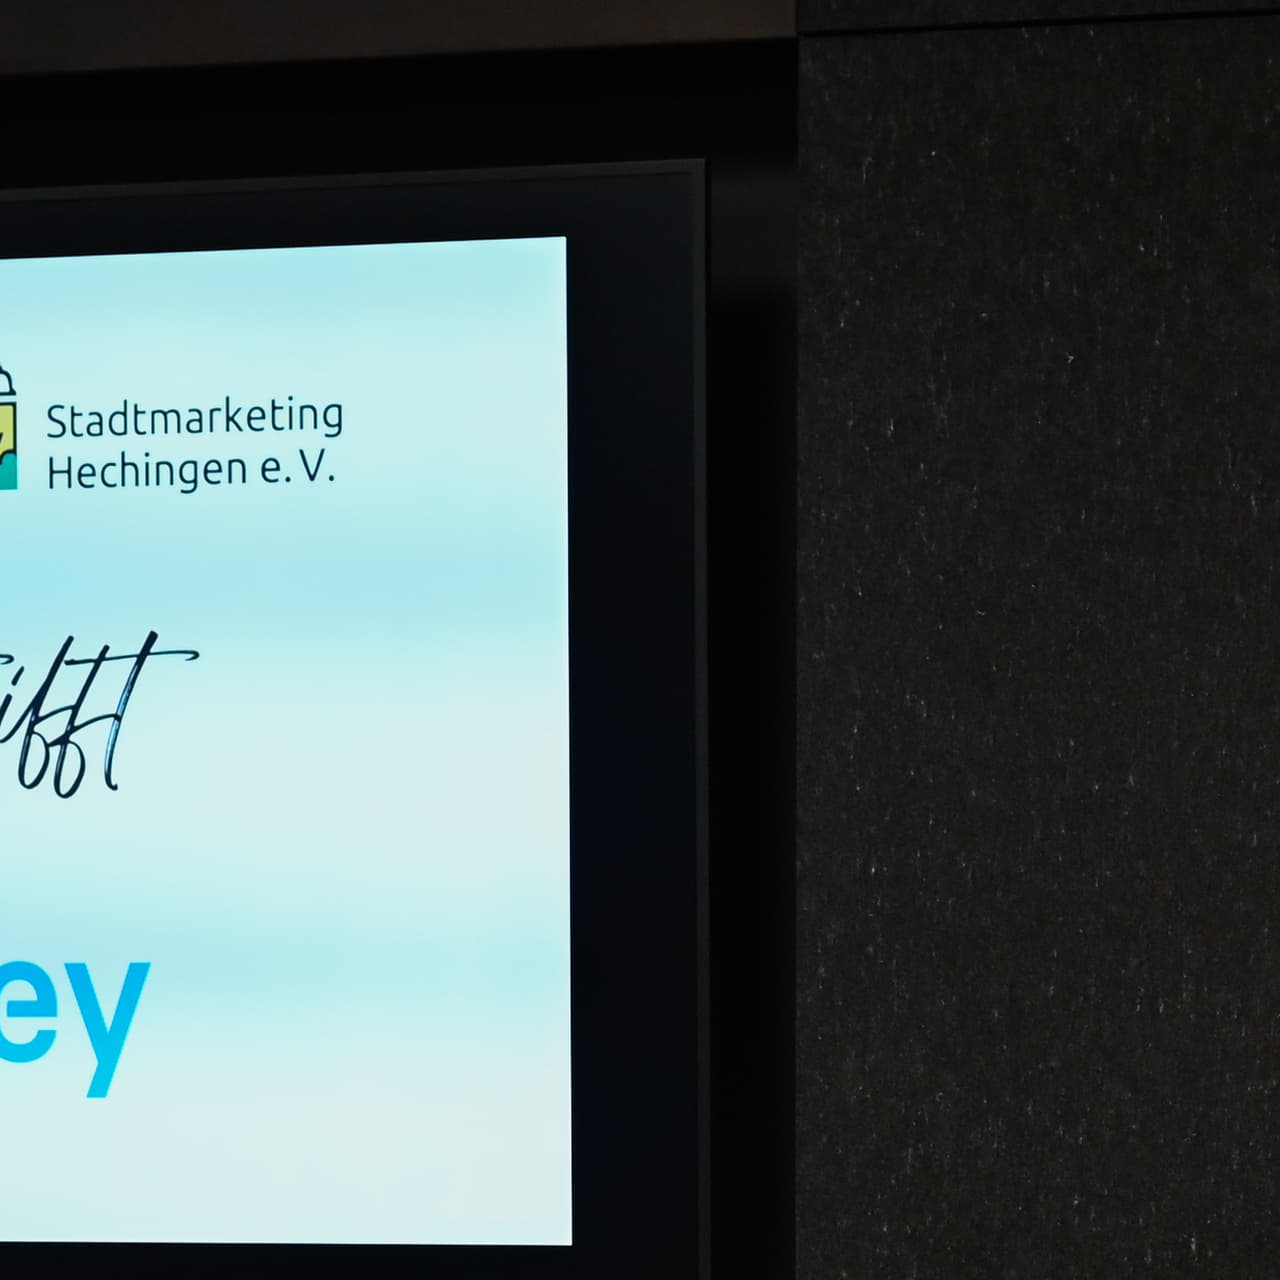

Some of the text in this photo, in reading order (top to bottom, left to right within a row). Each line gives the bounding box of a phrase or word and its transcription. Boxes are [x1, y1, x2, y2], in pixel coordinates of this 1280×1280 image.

[47, 395, 343, 439] Stadtmarketing
[48, 448, 335, 495] Hechingen e. V.
